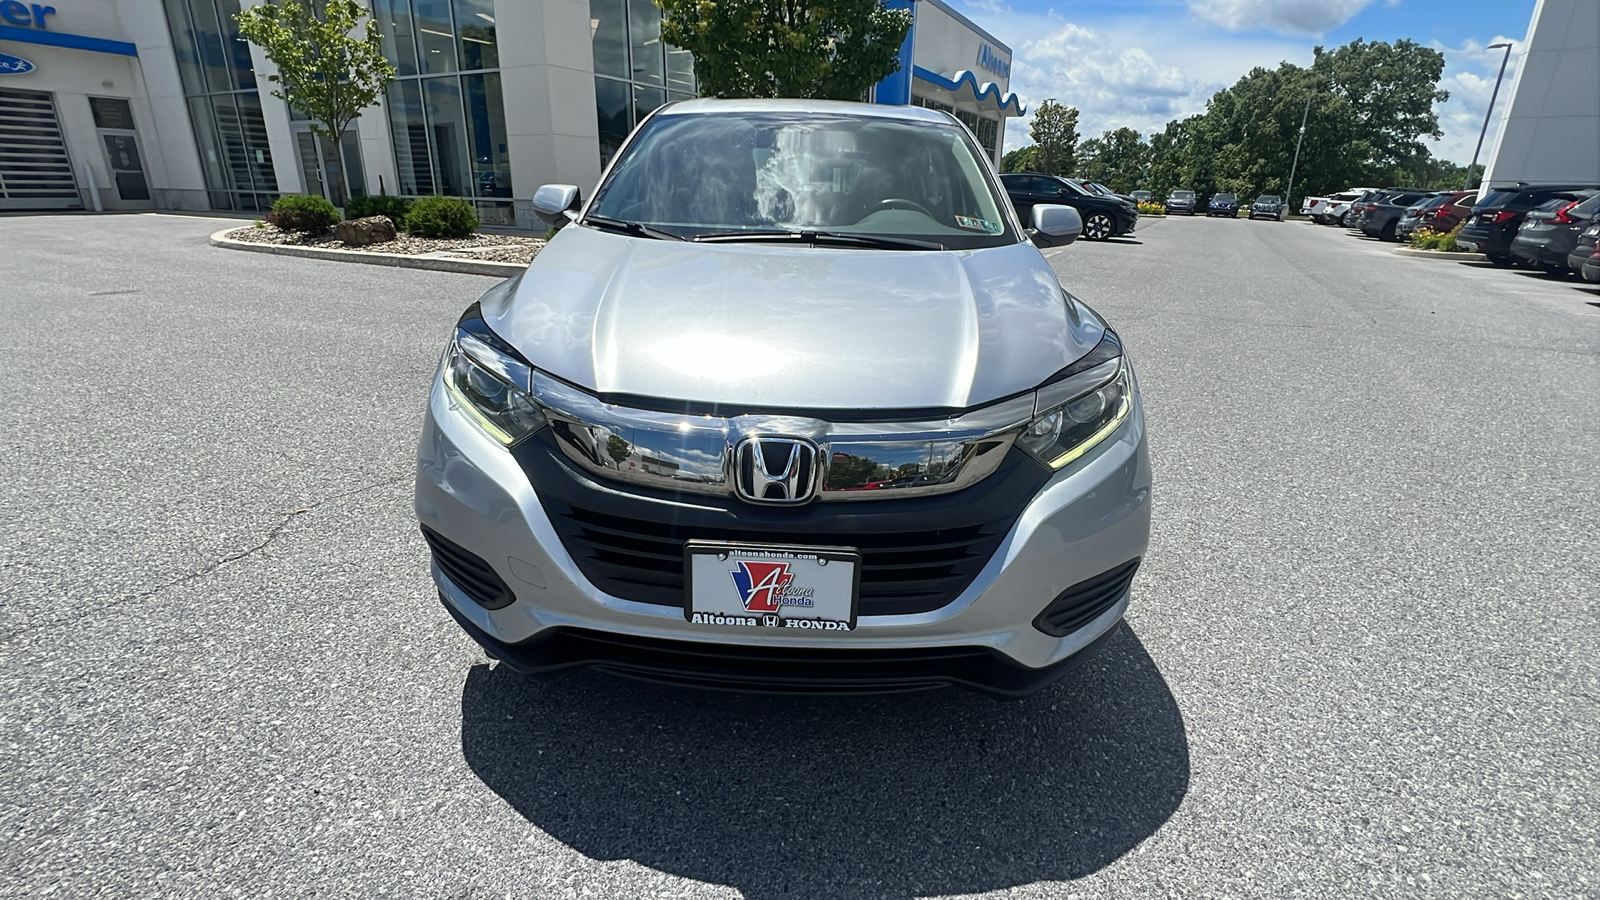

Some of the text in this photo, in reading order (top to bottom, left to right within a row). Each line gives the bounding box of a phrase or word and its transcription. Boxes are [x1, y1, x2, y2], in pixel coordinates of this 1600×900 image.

[728, 550, 818, 560] altoonahonda.com
[744, 567, 814, 605] Altoona
[772, 594, 813, 607] Honda
[692, 613, 757, 626] Altoona
[785, 619, 851, 631] HONDA
